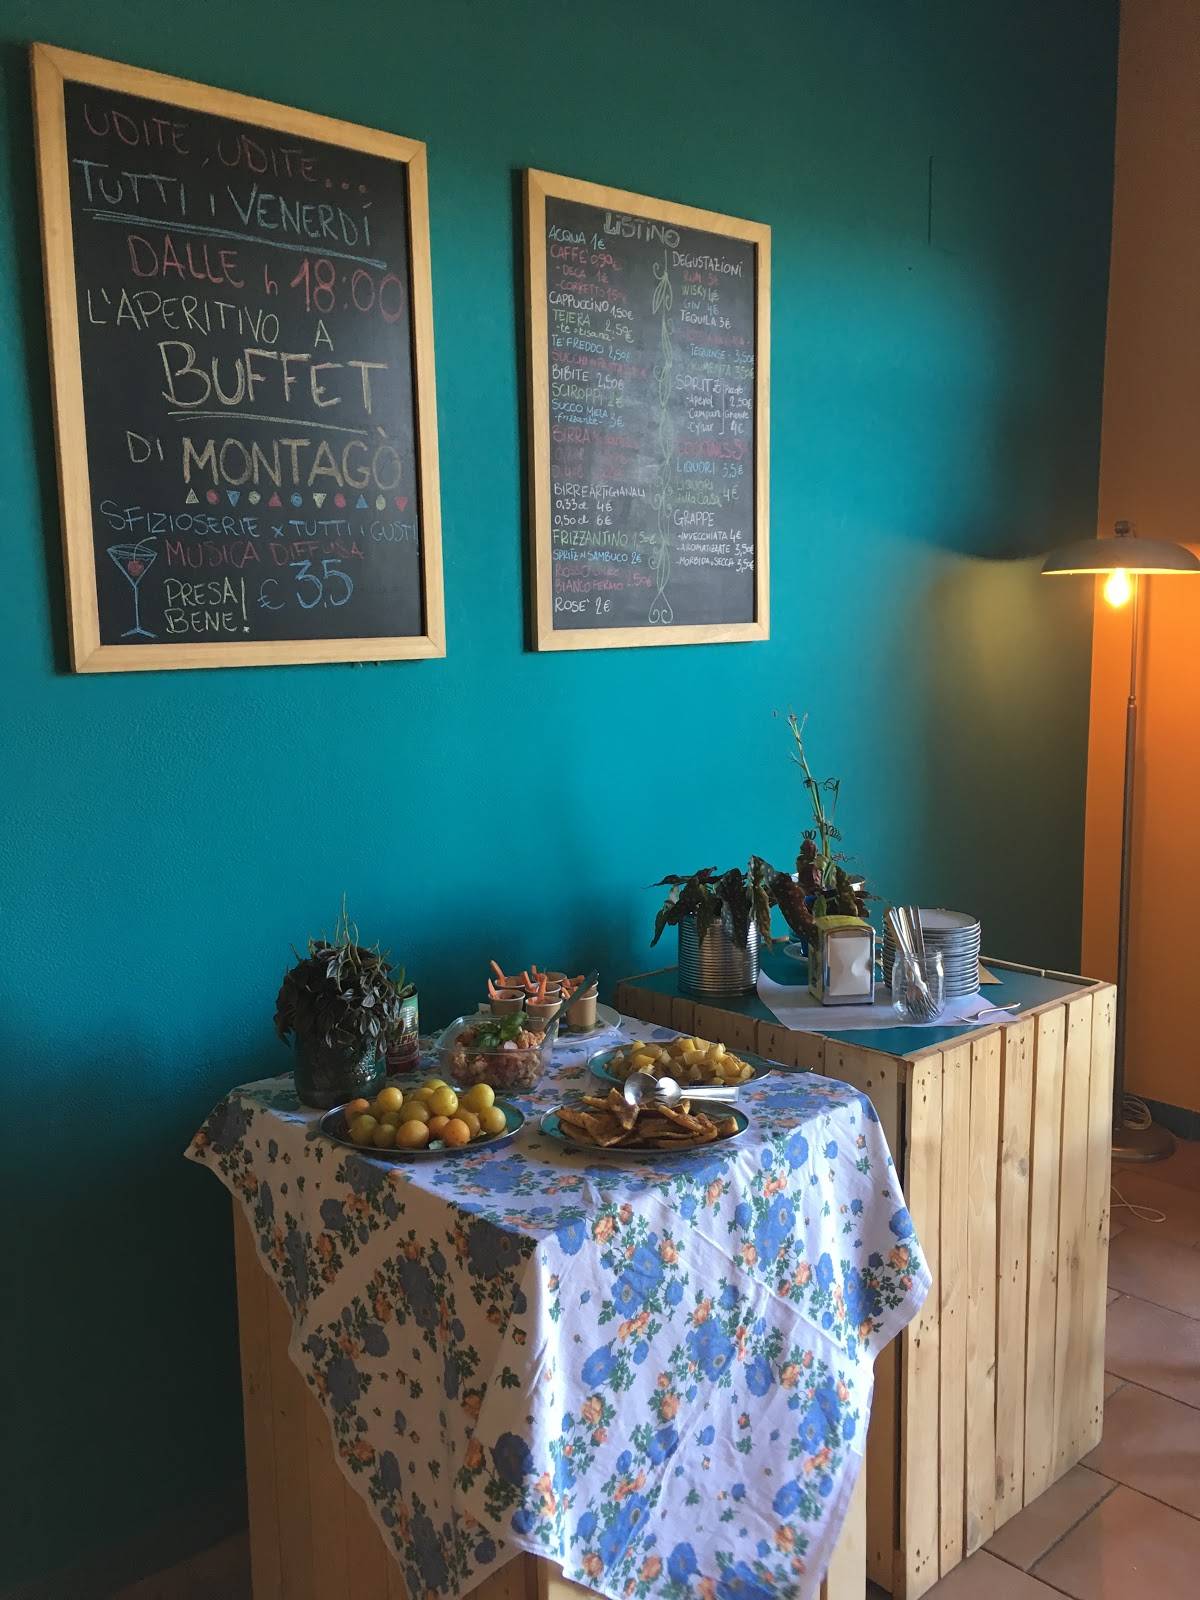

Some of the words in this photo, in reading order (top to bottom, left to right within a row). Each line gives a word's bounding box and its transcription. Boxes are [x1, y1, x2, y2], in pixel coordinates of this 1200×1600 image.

[73, 159, 187, 215] TUTTI
[548, 225, 586, 245] ACQUA
[127, 234, 245, 288] DALLE
[290, 258, 402, 323] 18:00
[87, 288, 280, 344] L'APERITIVO
[313, 319, 334, 351] A
[680, 309, 717, 327] TEQUILA
[566, 337, 604, 354] FREDDO
[157, 340, 388, 414] BUFFET
[552, 363, 589, 381] BIBITE
[552, 382, 603, 405] SCIROPPI
[554, 482, 588, 497] BIRRE
[100, 500, 260, 540] SFIZIOSERIE
[288, 519, 351, 537] TUTTI
[674, 508, 715, 527] GRAPPE
[552, 529, 628, 547] FRIZZANTINO
[165, 540, 260, 569] MUSICA
[587, 551, 628, 562] SAMBUCO
[257, 579, 286, 610] €
[596, 597, 611, 614] 2€
